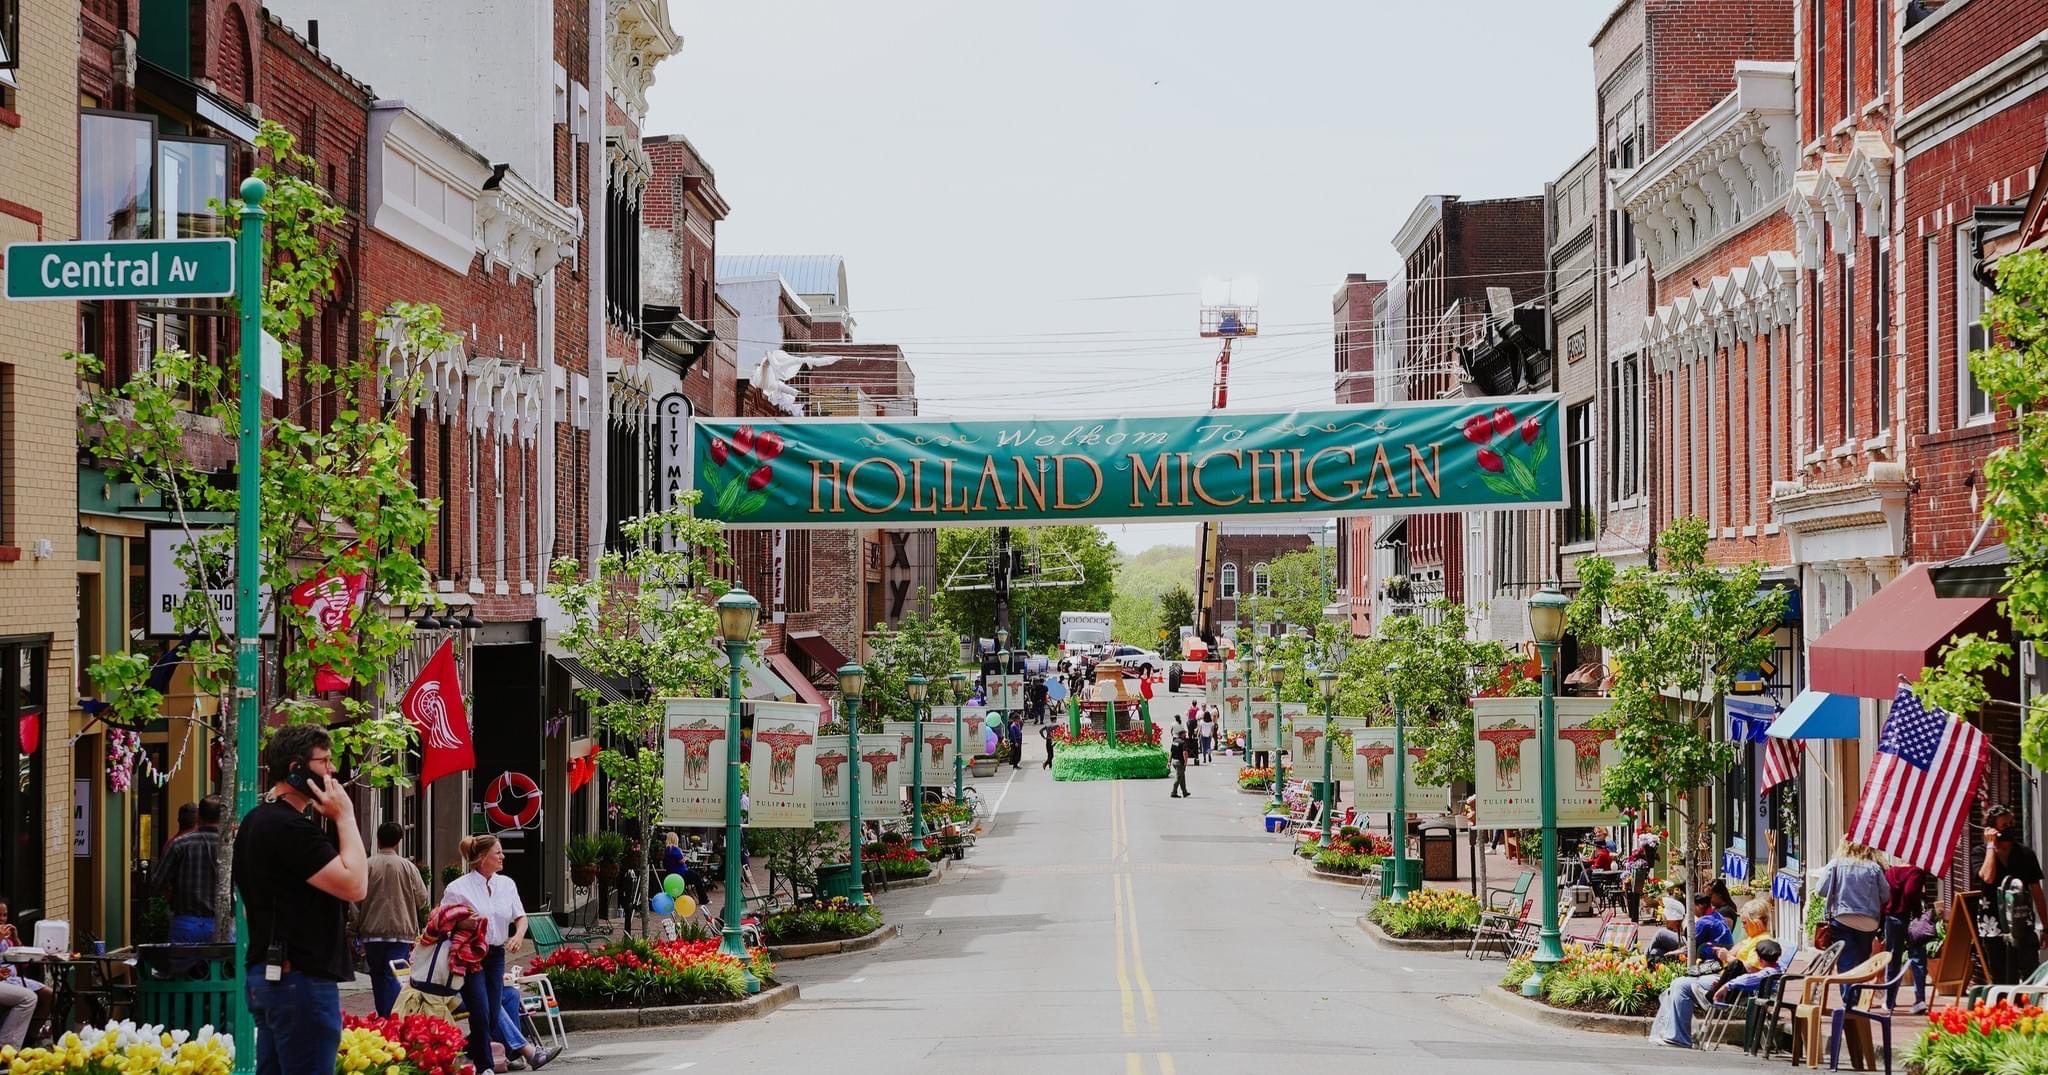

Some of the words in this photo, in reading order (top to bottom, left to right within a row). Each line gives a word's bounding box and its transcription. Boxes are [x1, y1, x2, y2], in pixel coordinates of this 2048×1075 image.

[41, 251, 159, 288] Central
[168, 255, 198, 282] Av
[668, 402, 680, 457] CITY
[997, 424, 1169, 448] Welkom
[1196, 423, 1248, 444] To
[808, 453, 1103, 514] HOLLAND
[1127, 442, 1443, 508] MICHIGAN
[774, 557, 782, 598] PETE
